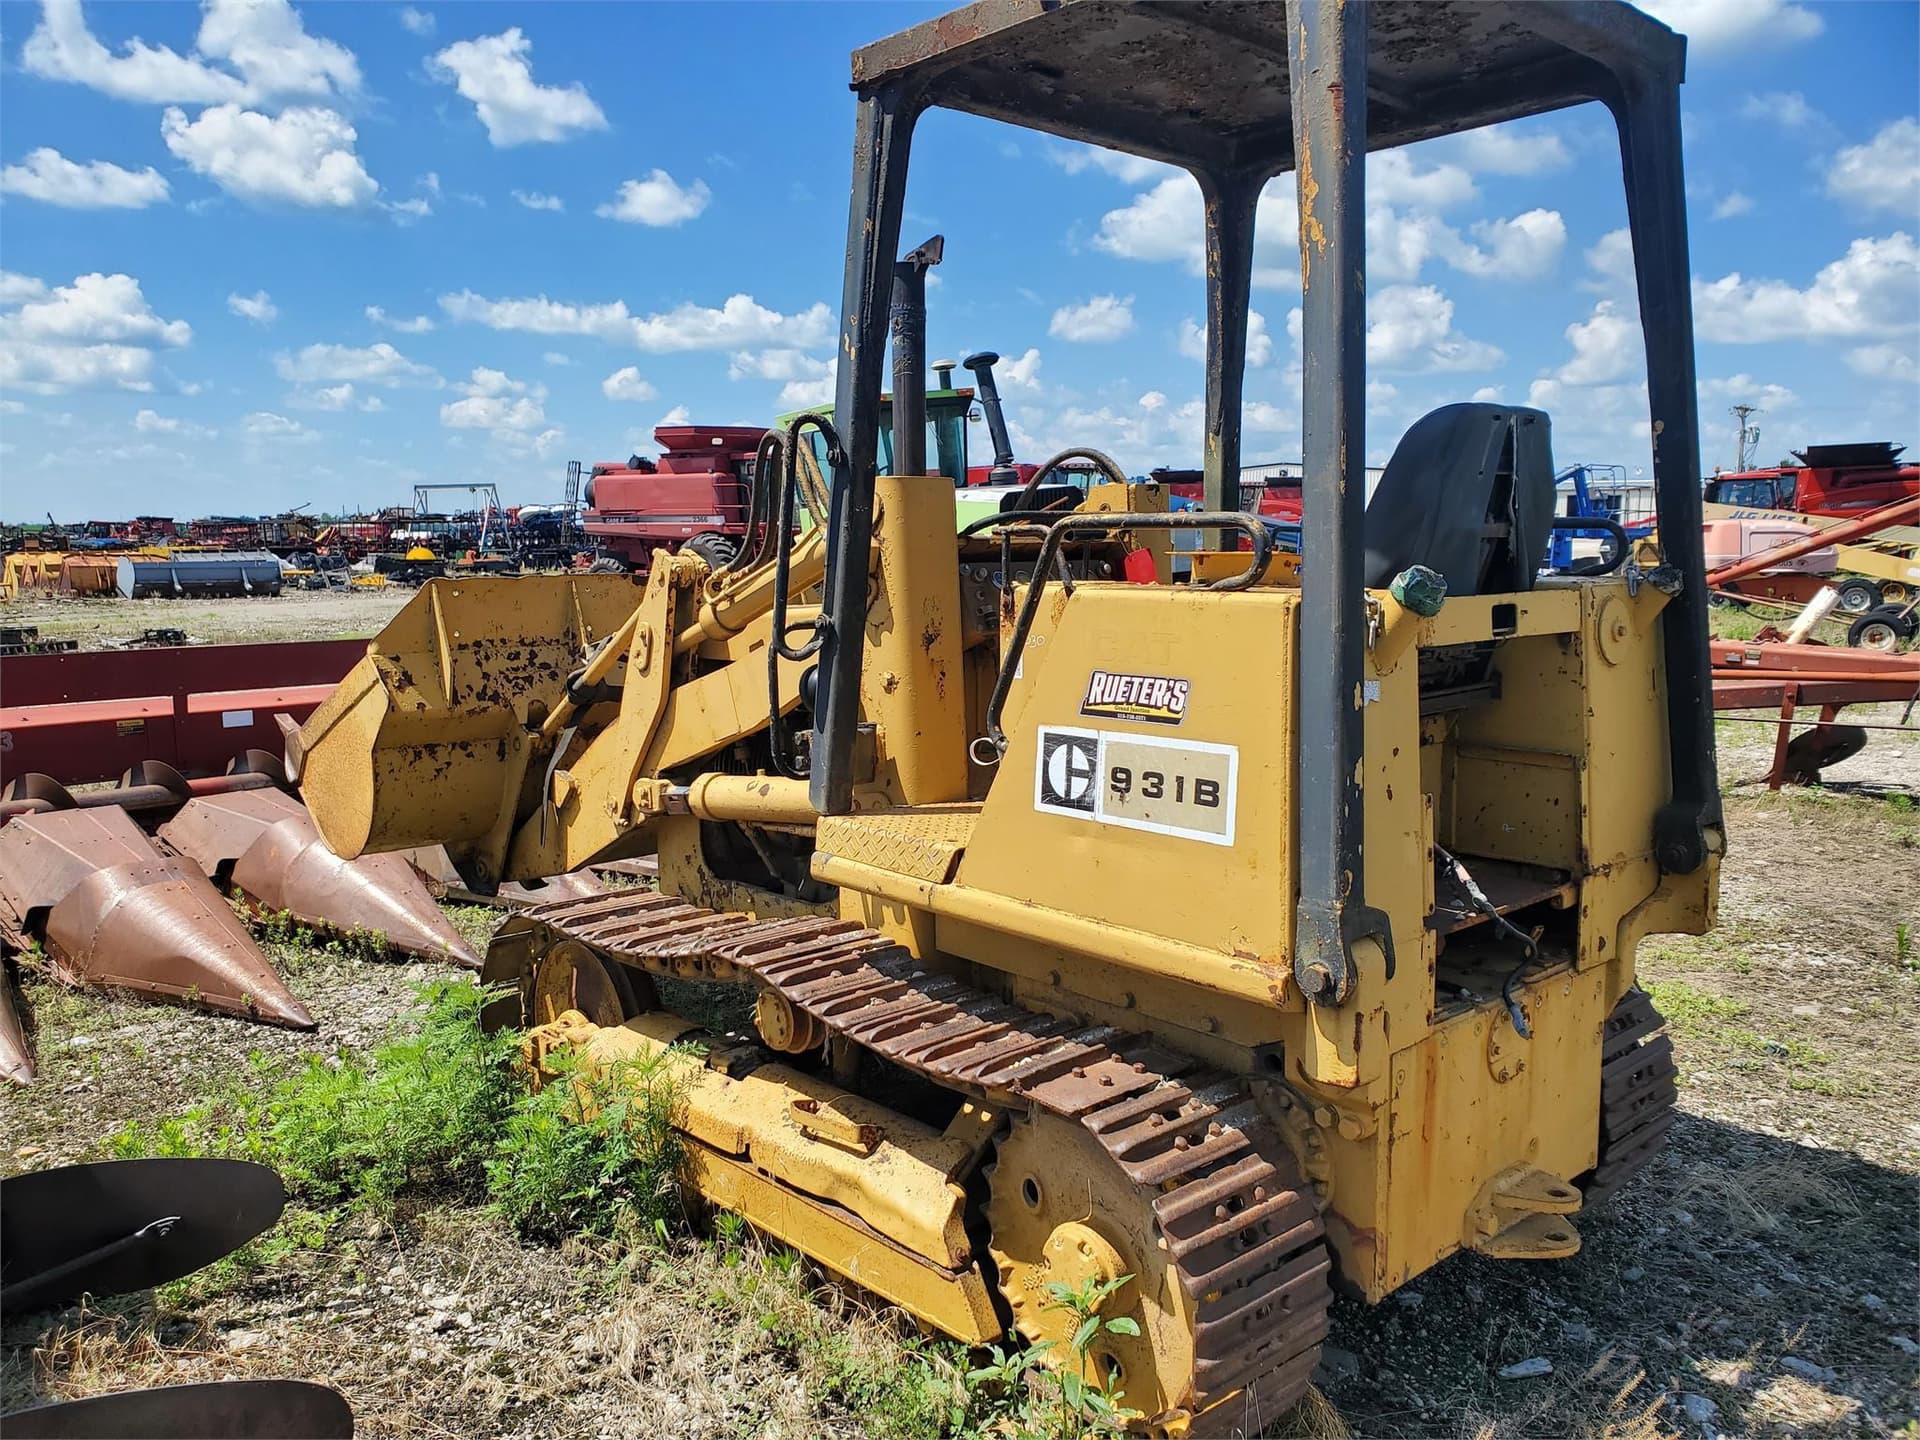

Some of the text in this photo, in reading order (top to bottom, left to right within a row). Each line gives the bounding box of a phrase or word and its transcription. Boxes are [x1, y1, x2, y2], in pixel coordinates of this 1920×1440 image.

[1729, 510, 1758, 519] JLG
[1087, 671, 1188, 713] RUETER'S
[1110, 766, 1220, 808] 931B
